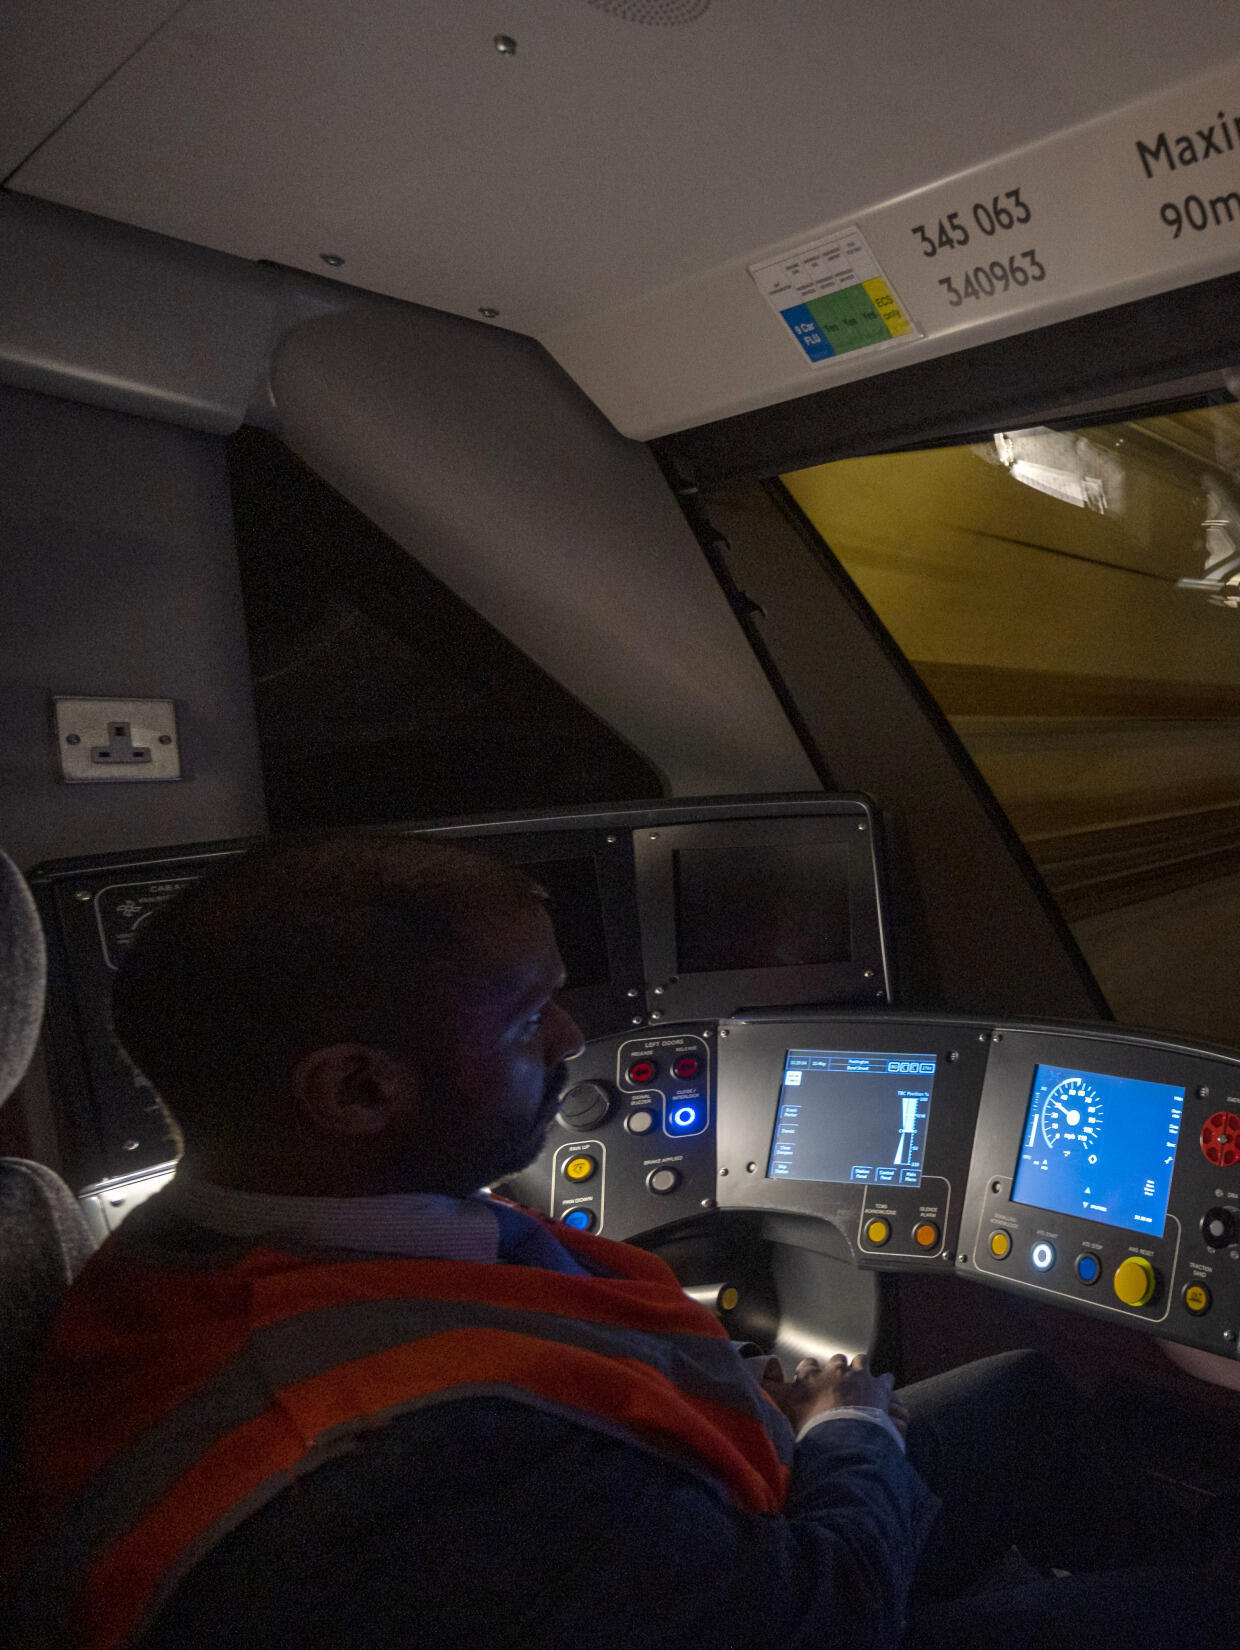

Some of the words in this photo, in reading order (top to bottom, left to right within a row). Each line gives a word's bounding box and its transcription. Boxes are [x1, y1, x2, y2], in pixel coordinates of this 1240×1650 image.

[912, 212, 969, 257] 345
[973, 187, 1031, 236] 063
[875, 295, 894, 308] ECS
[938, 248, 1046, 306] 340963
